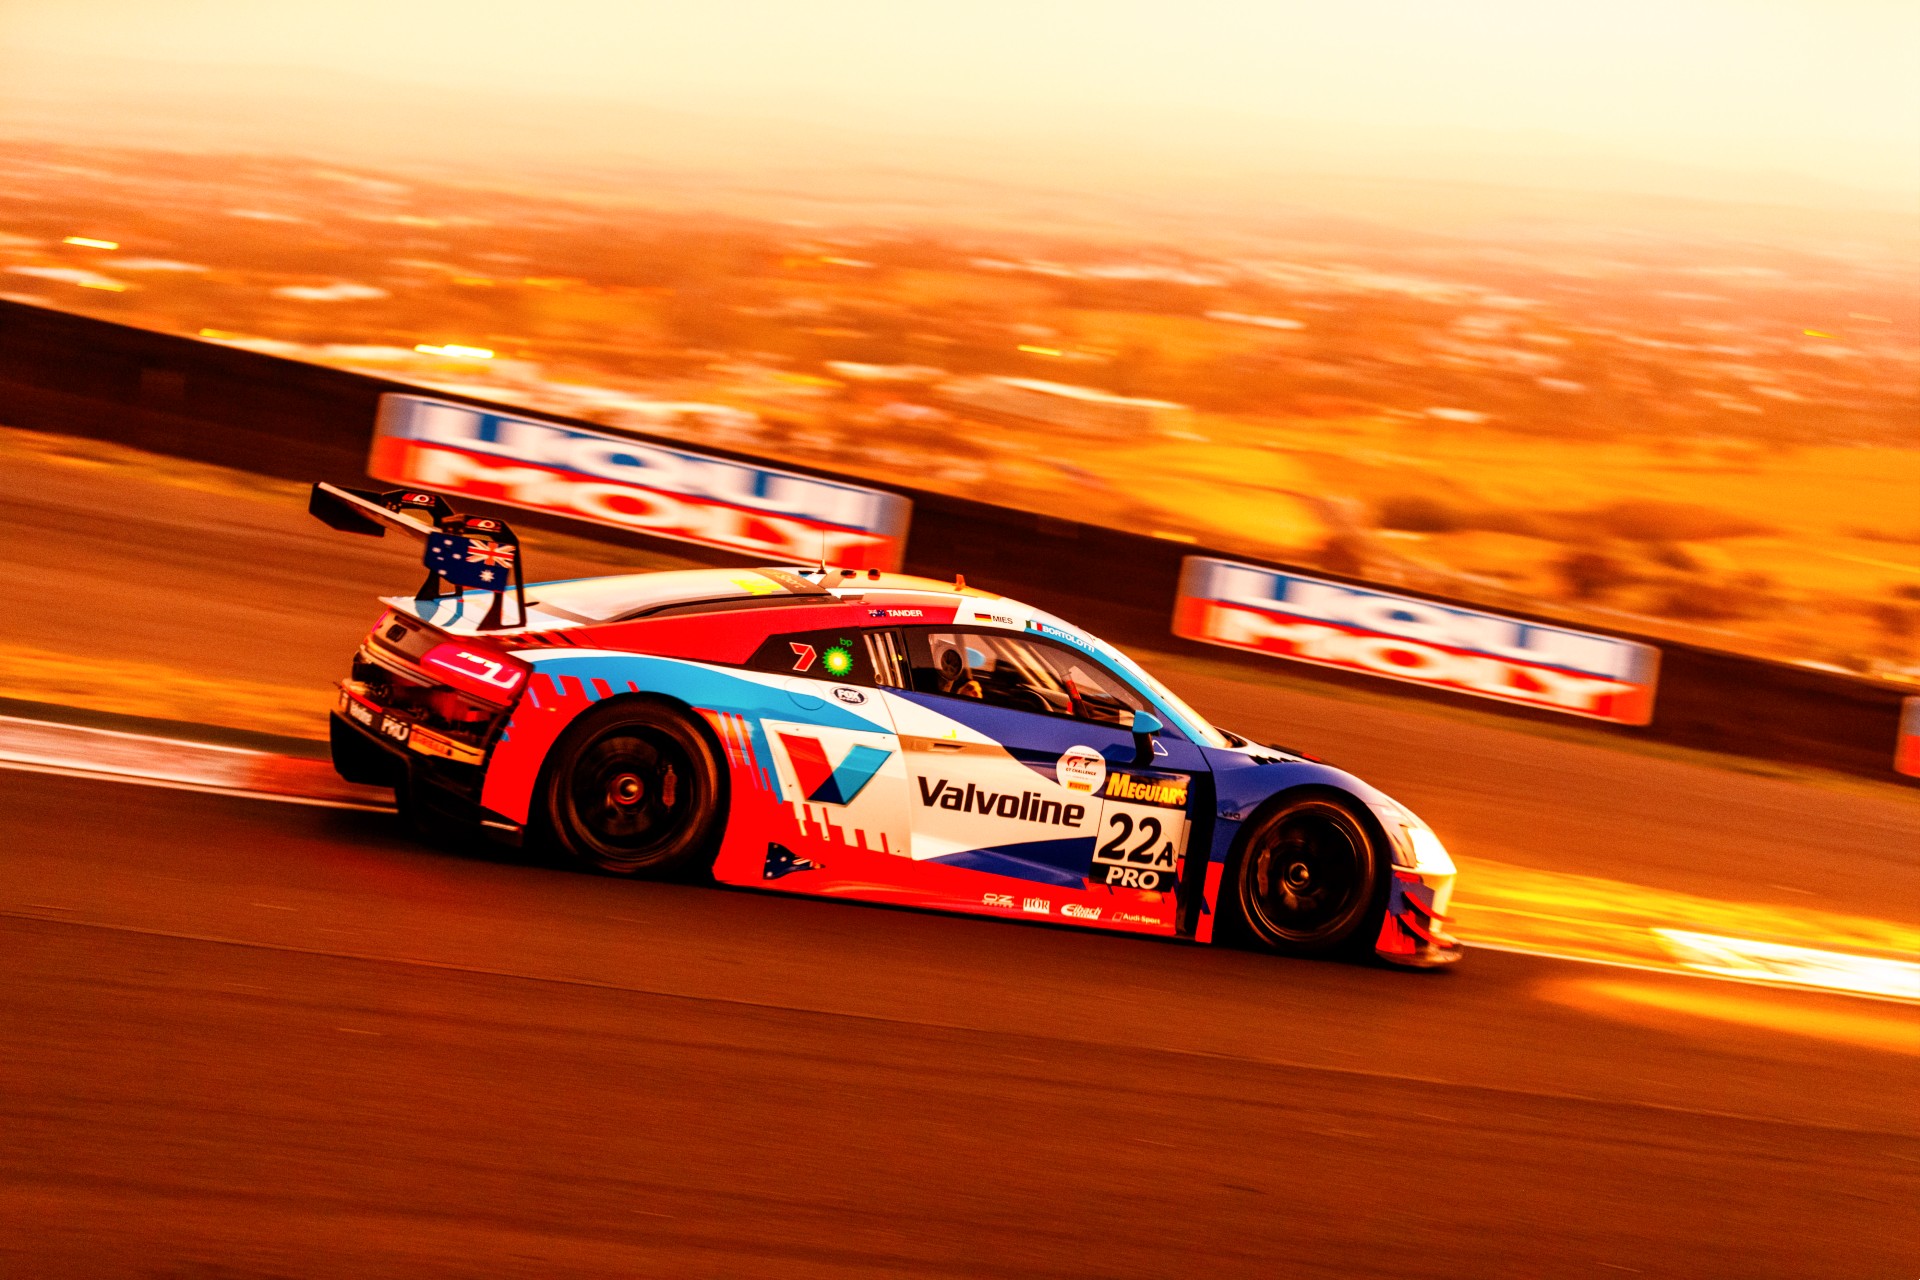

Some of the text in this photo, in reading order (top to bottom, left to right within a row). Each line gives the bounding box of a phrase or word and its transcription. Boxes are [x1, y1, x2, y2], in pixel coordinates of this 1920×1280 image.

[886, 609, 923, 617] TANDER
[992, 615, 1014, 625] MIES
[839, 637, 853, 647] bp
[1042, 625, 1096, 653] BORTOLOTTI
[836, 688, 862, 700] FOX
[917, 776, 1086, 828] Valvoline
[1106, 866, 1160, 890] PRO
[1061, 903, 1102, 919] Eibach
[1122, 912, 1160, 925] Audi Sport
